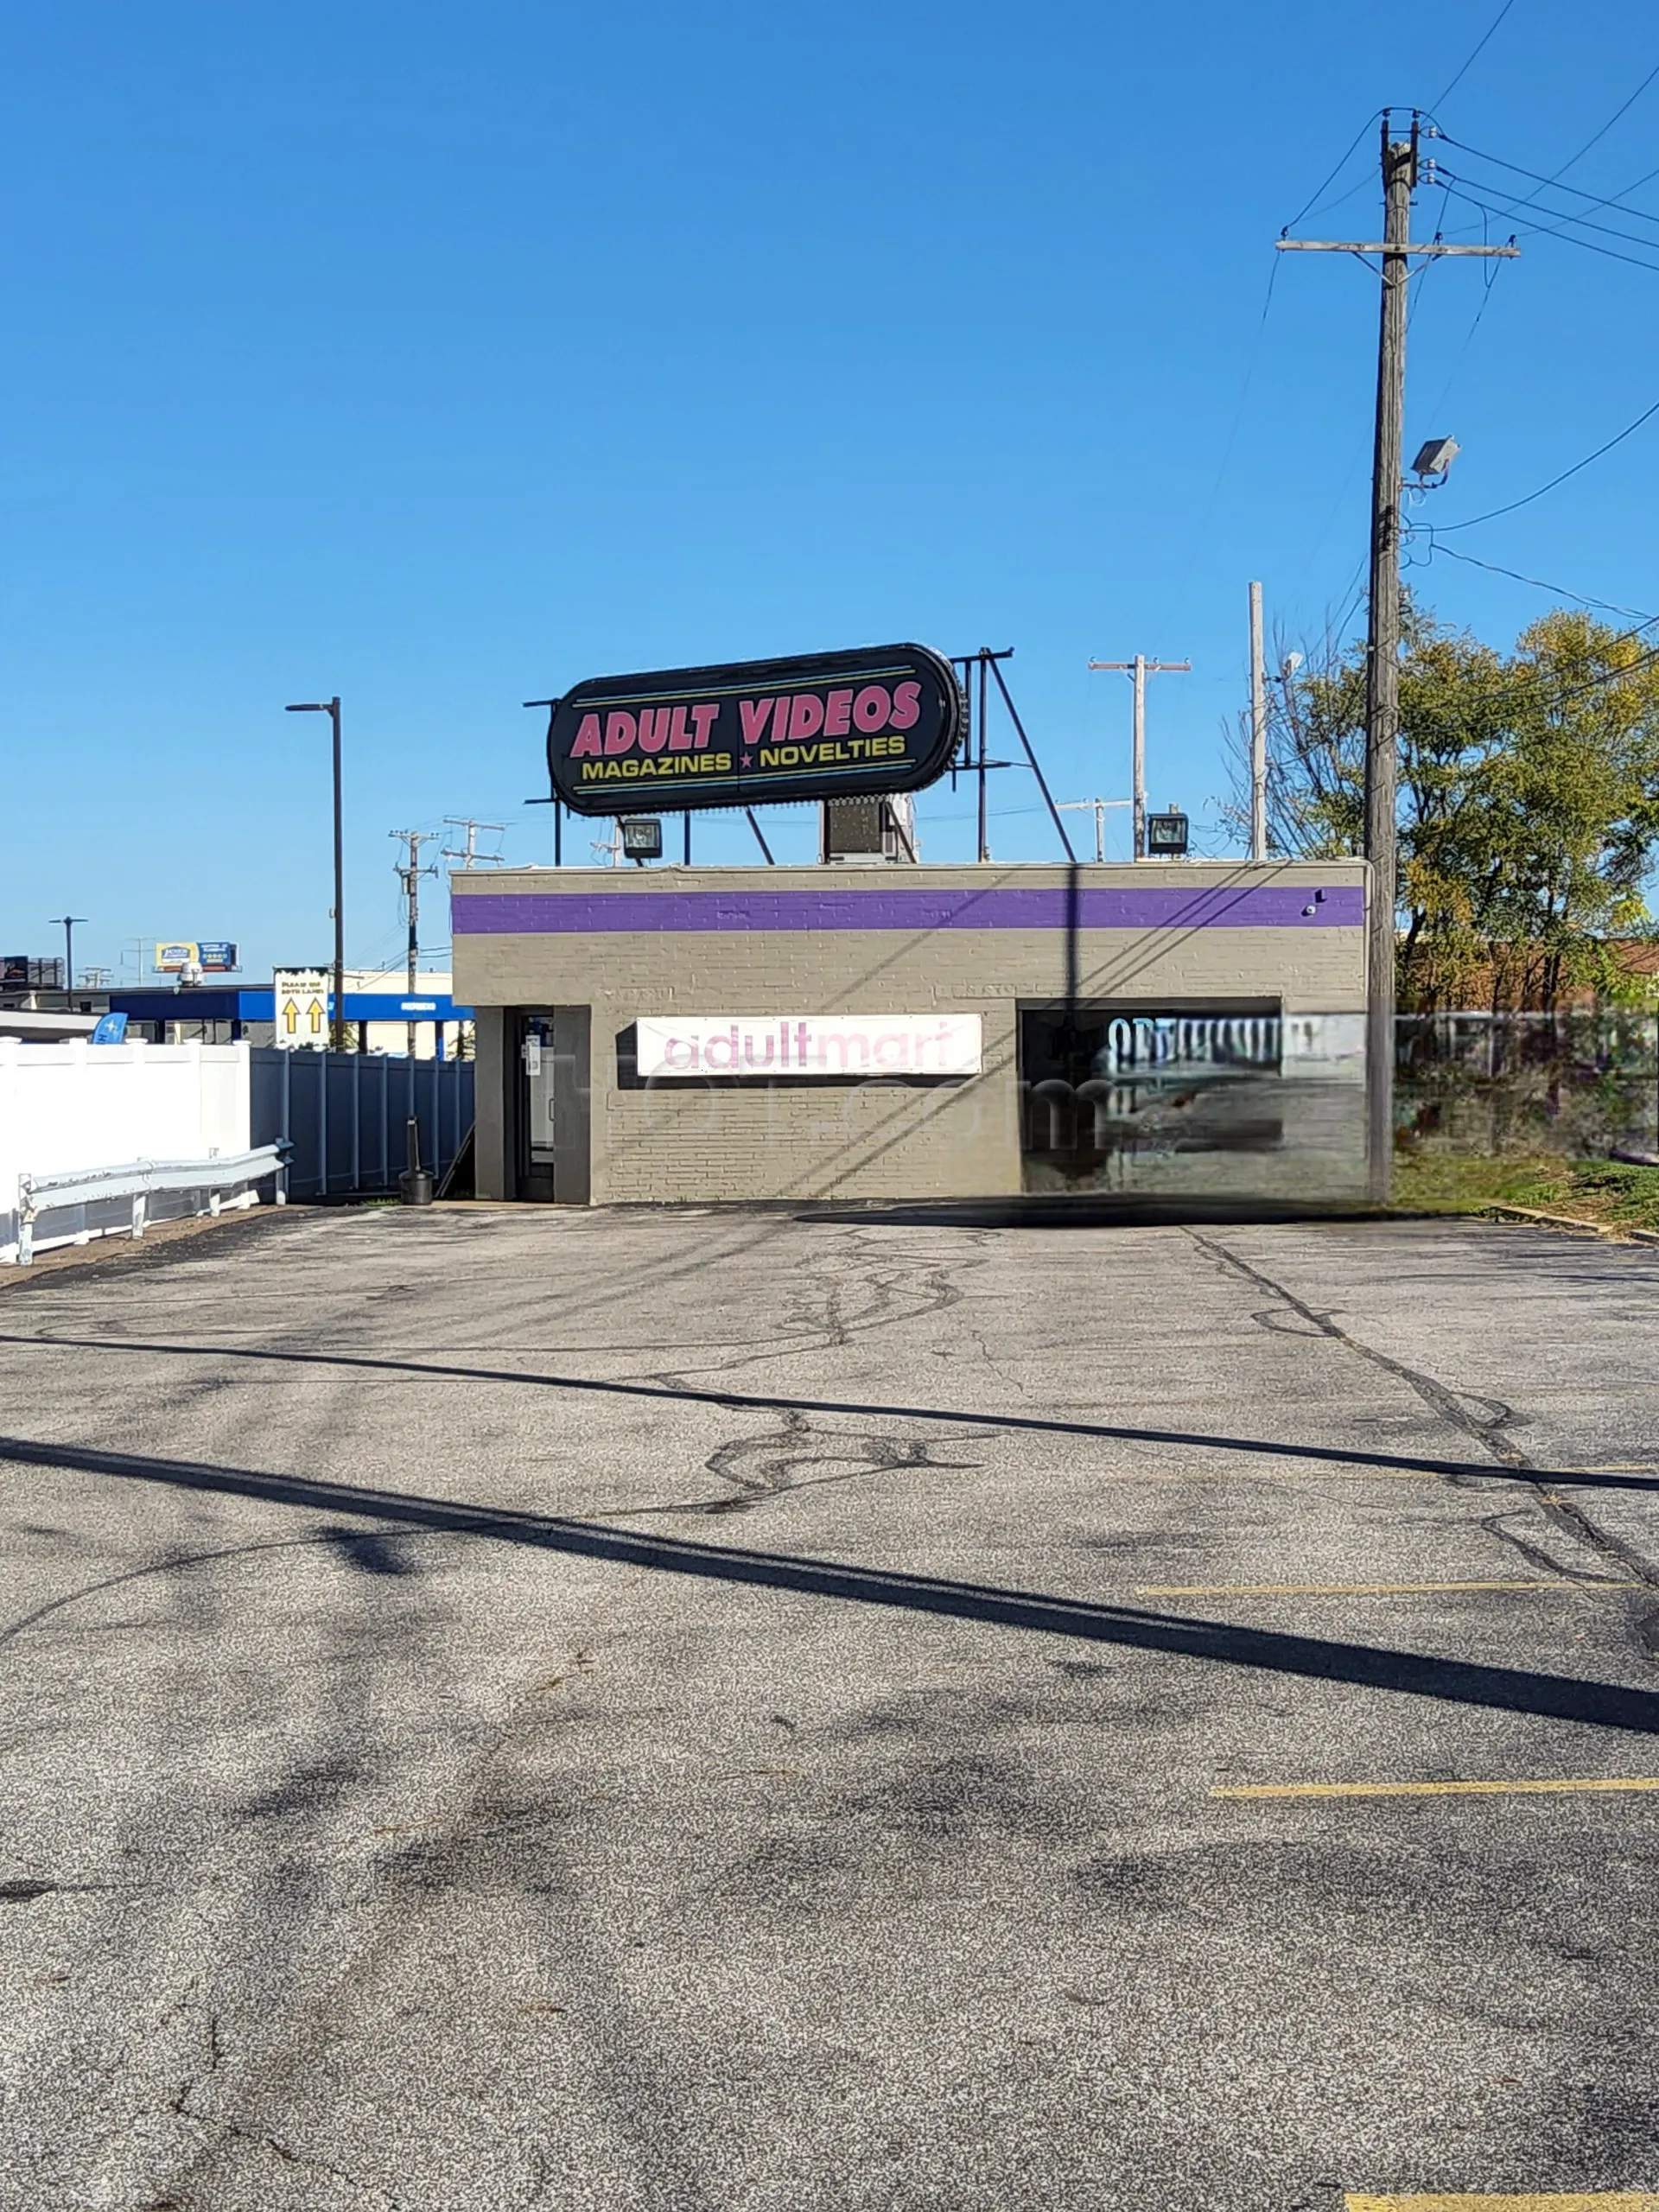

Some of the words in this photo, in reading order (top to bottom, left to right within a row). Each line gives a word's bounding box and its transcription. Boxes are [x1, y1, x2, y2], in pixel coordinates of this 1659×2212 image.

[569, 703, 720, 758] ADULT
[738, 681, 922, 745] VIDEOS
[582, 753, 732, 780] MAGAZINES
[760, 734, 906, 766] NOVELTIES
[664, 1020, 952, 1070] adultmart
